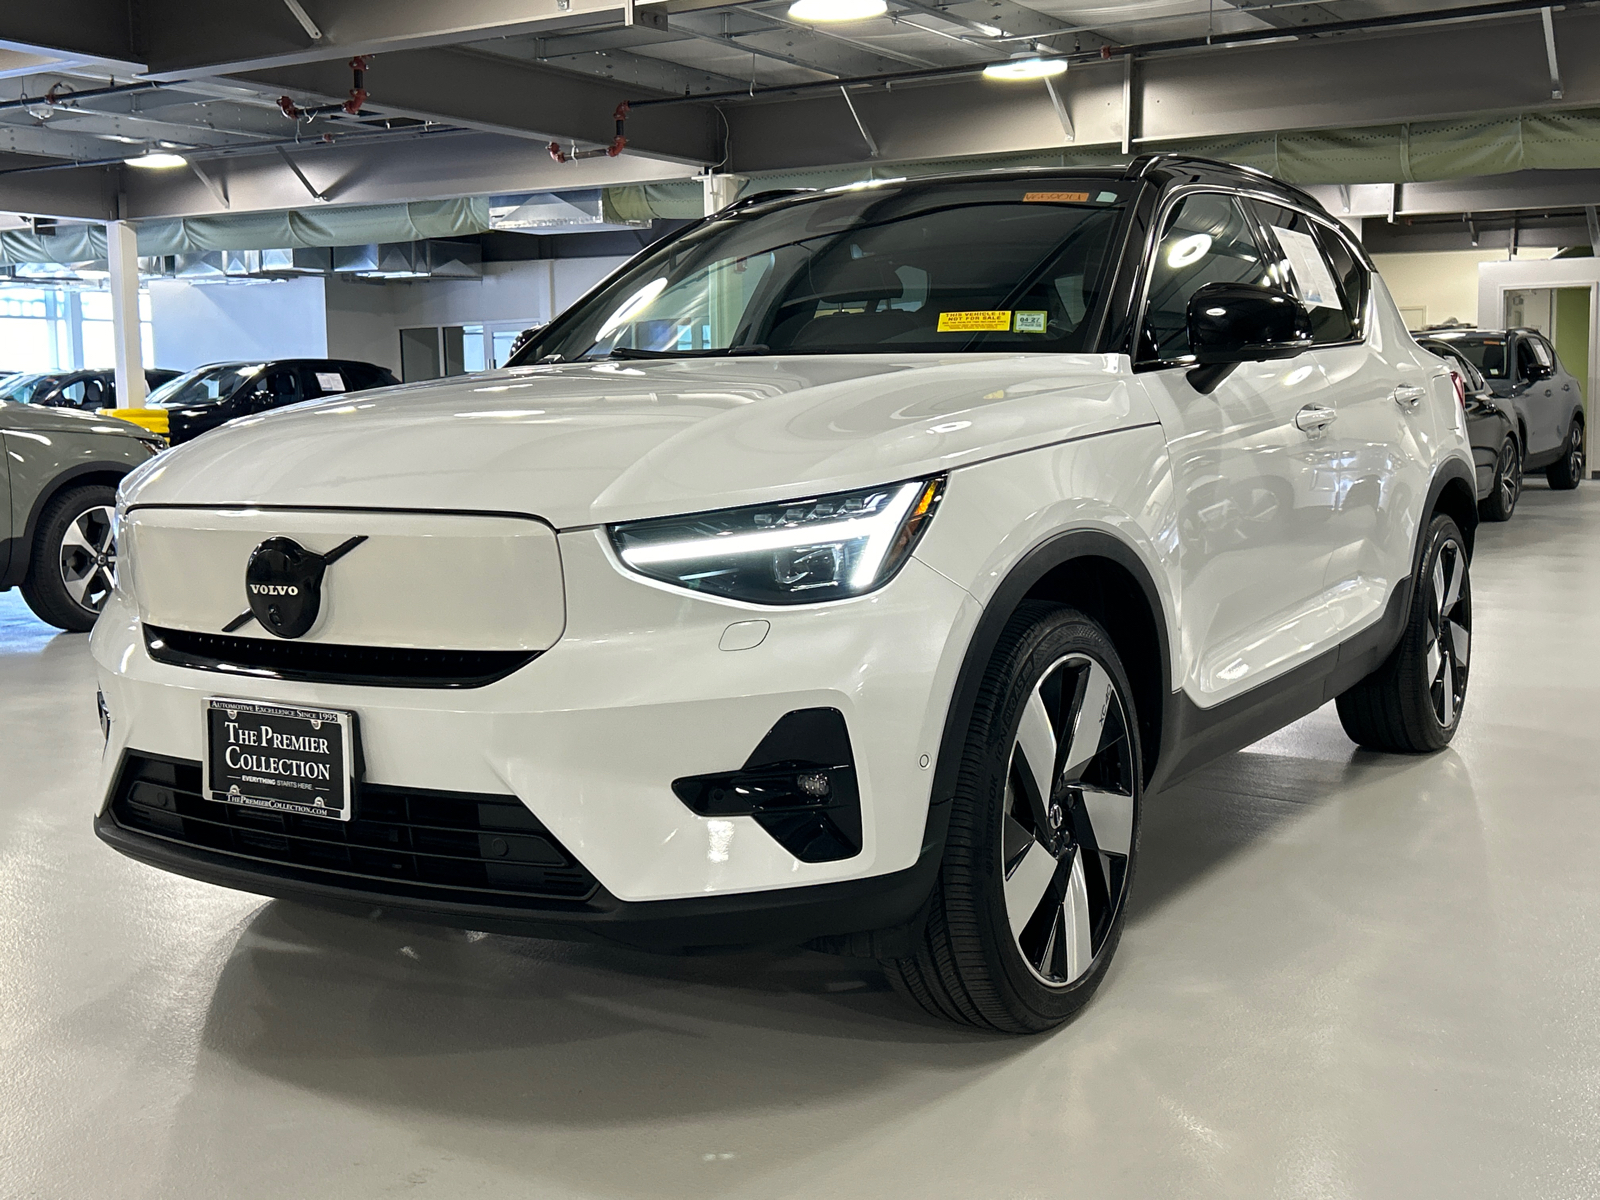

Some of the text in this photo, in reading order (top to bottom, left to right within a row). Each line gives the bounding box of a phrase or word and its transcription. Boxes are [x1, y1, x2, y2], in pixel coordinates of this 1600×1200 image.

[250, 584, 299, 596] VOLVO
[212, 701, 337, 722] AUTOMOTIVE EXCELLENCE SINCE 1995
[224, 721, 330, 754] THE PREMIER
[225, 745, 331, 780] COLLECTION
[242, 775, 276, 786] EVERYTHING
[276, 780, 297, 788] STARTS
